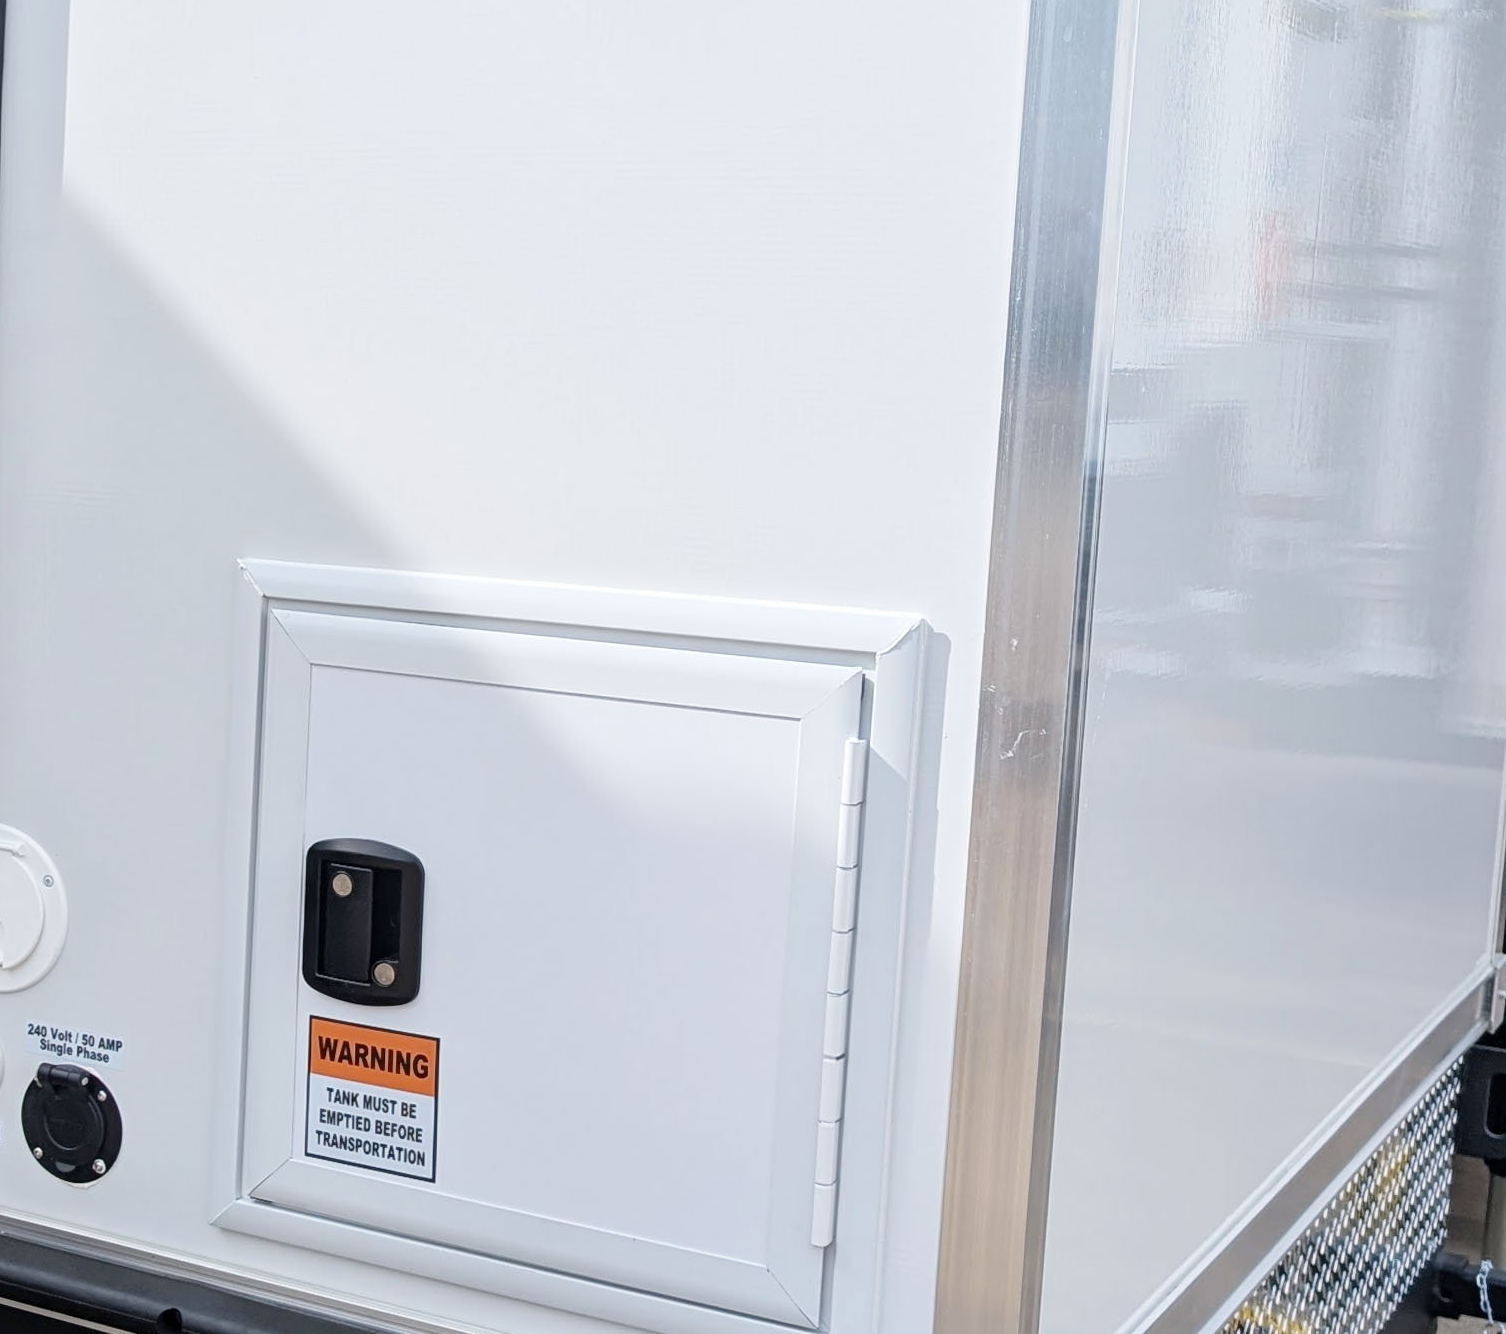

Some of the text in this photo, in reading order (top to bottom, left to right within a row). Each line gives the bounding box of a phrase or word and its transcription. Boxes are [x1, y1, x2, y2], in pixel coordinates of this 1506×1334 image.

[27, 1023, 47, 1038] 240
[50, 1027, 72, 1043] Volt
[81, 1034, 95, 1047] 50
[98, 1037, 123, 1053] AMP
[40, 1038, 110, 1064] Single Phase
[318, 1035, 429, 1079] WARNING
[326, 1087, 417, 1119] TANK MUST BE
[319, 1108, 423, 1143] EMPTIED BEFORE
[315, 1129, 425, 1167] TRANSPORTATION
